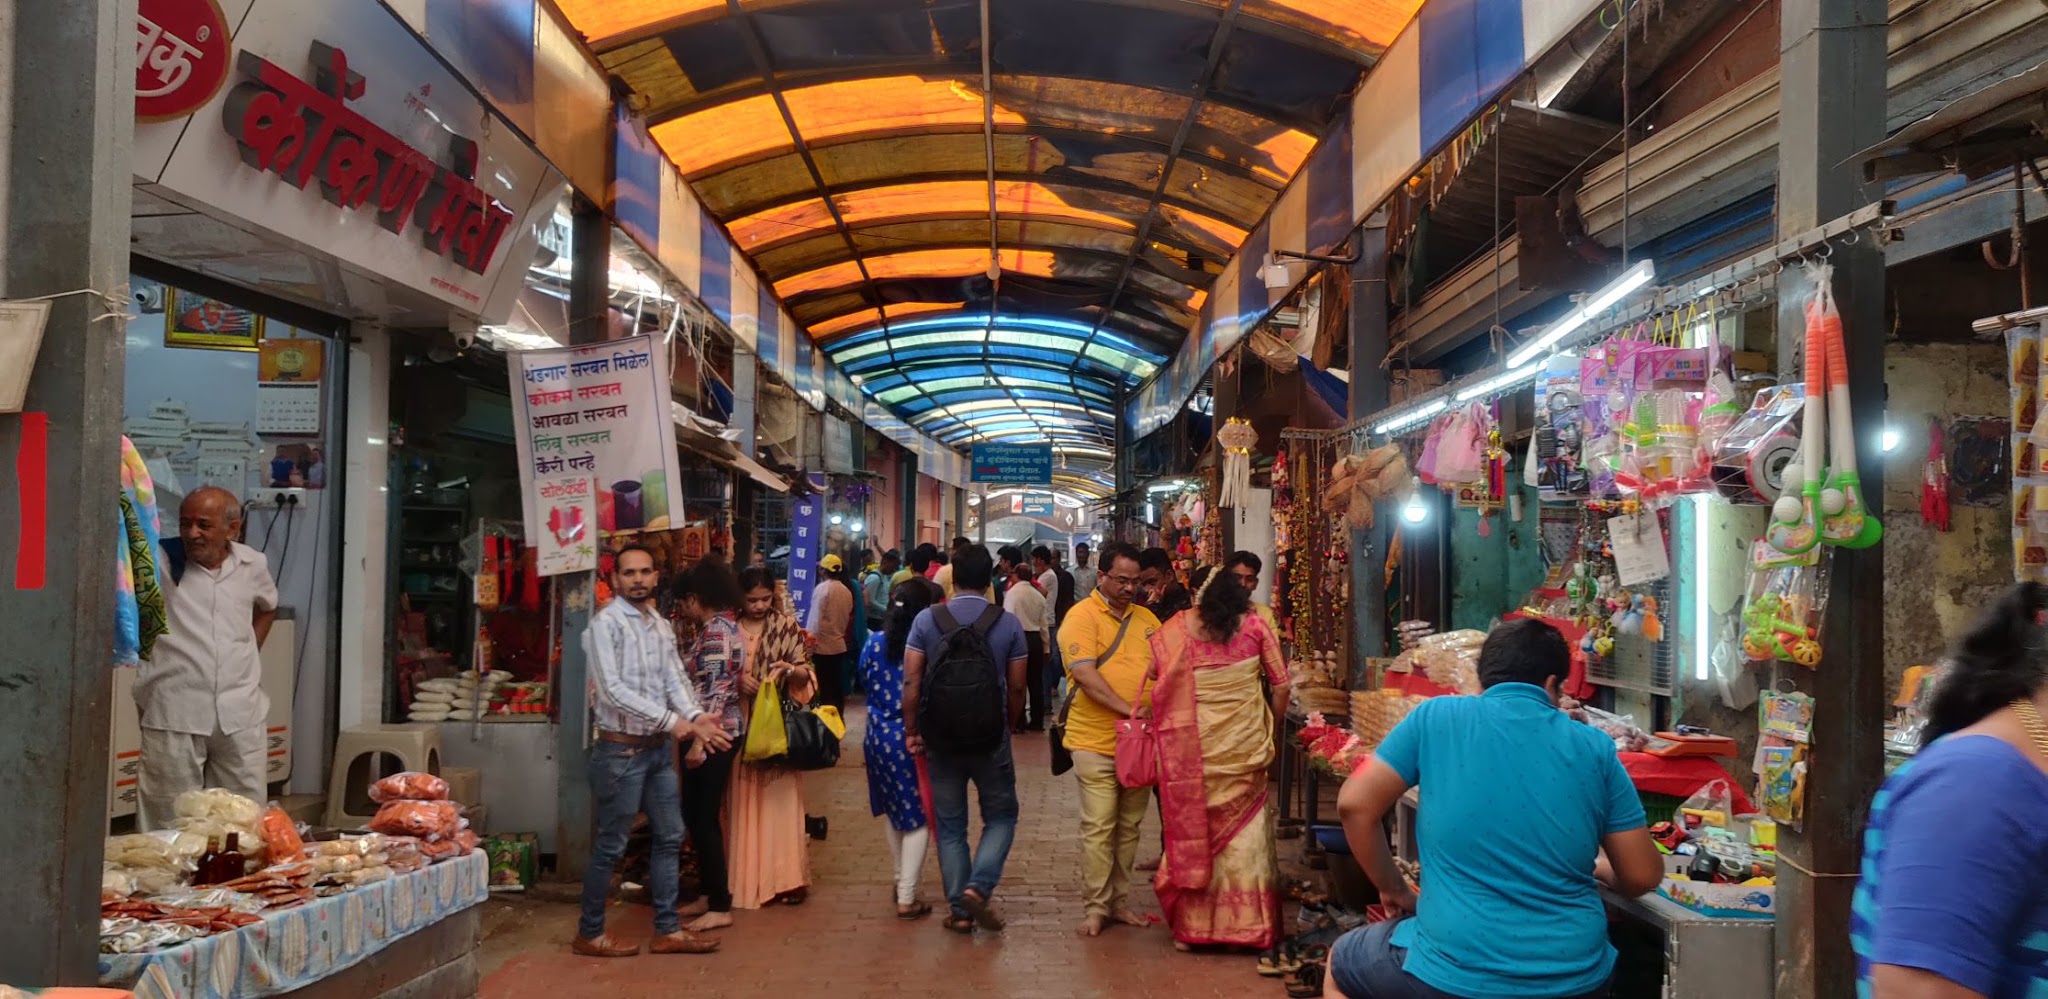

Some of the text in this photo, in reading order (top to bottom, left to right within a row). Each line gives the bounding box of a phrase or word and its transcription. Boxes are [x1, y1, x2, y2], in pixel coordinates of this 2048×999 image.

[223, 39, 514, 276] कोंकण मेवा
[525, 364, 567, 383] थंडगार
[570, 359, 609, 377] सरबत
[613, 349, 649, 371] मिळेल
[528, 382, 622, 406] कोकम सरबत
[533, 404, 628, 429] आवळा सरबत
[533, 430, 611, 455] लिंबू सरबत
